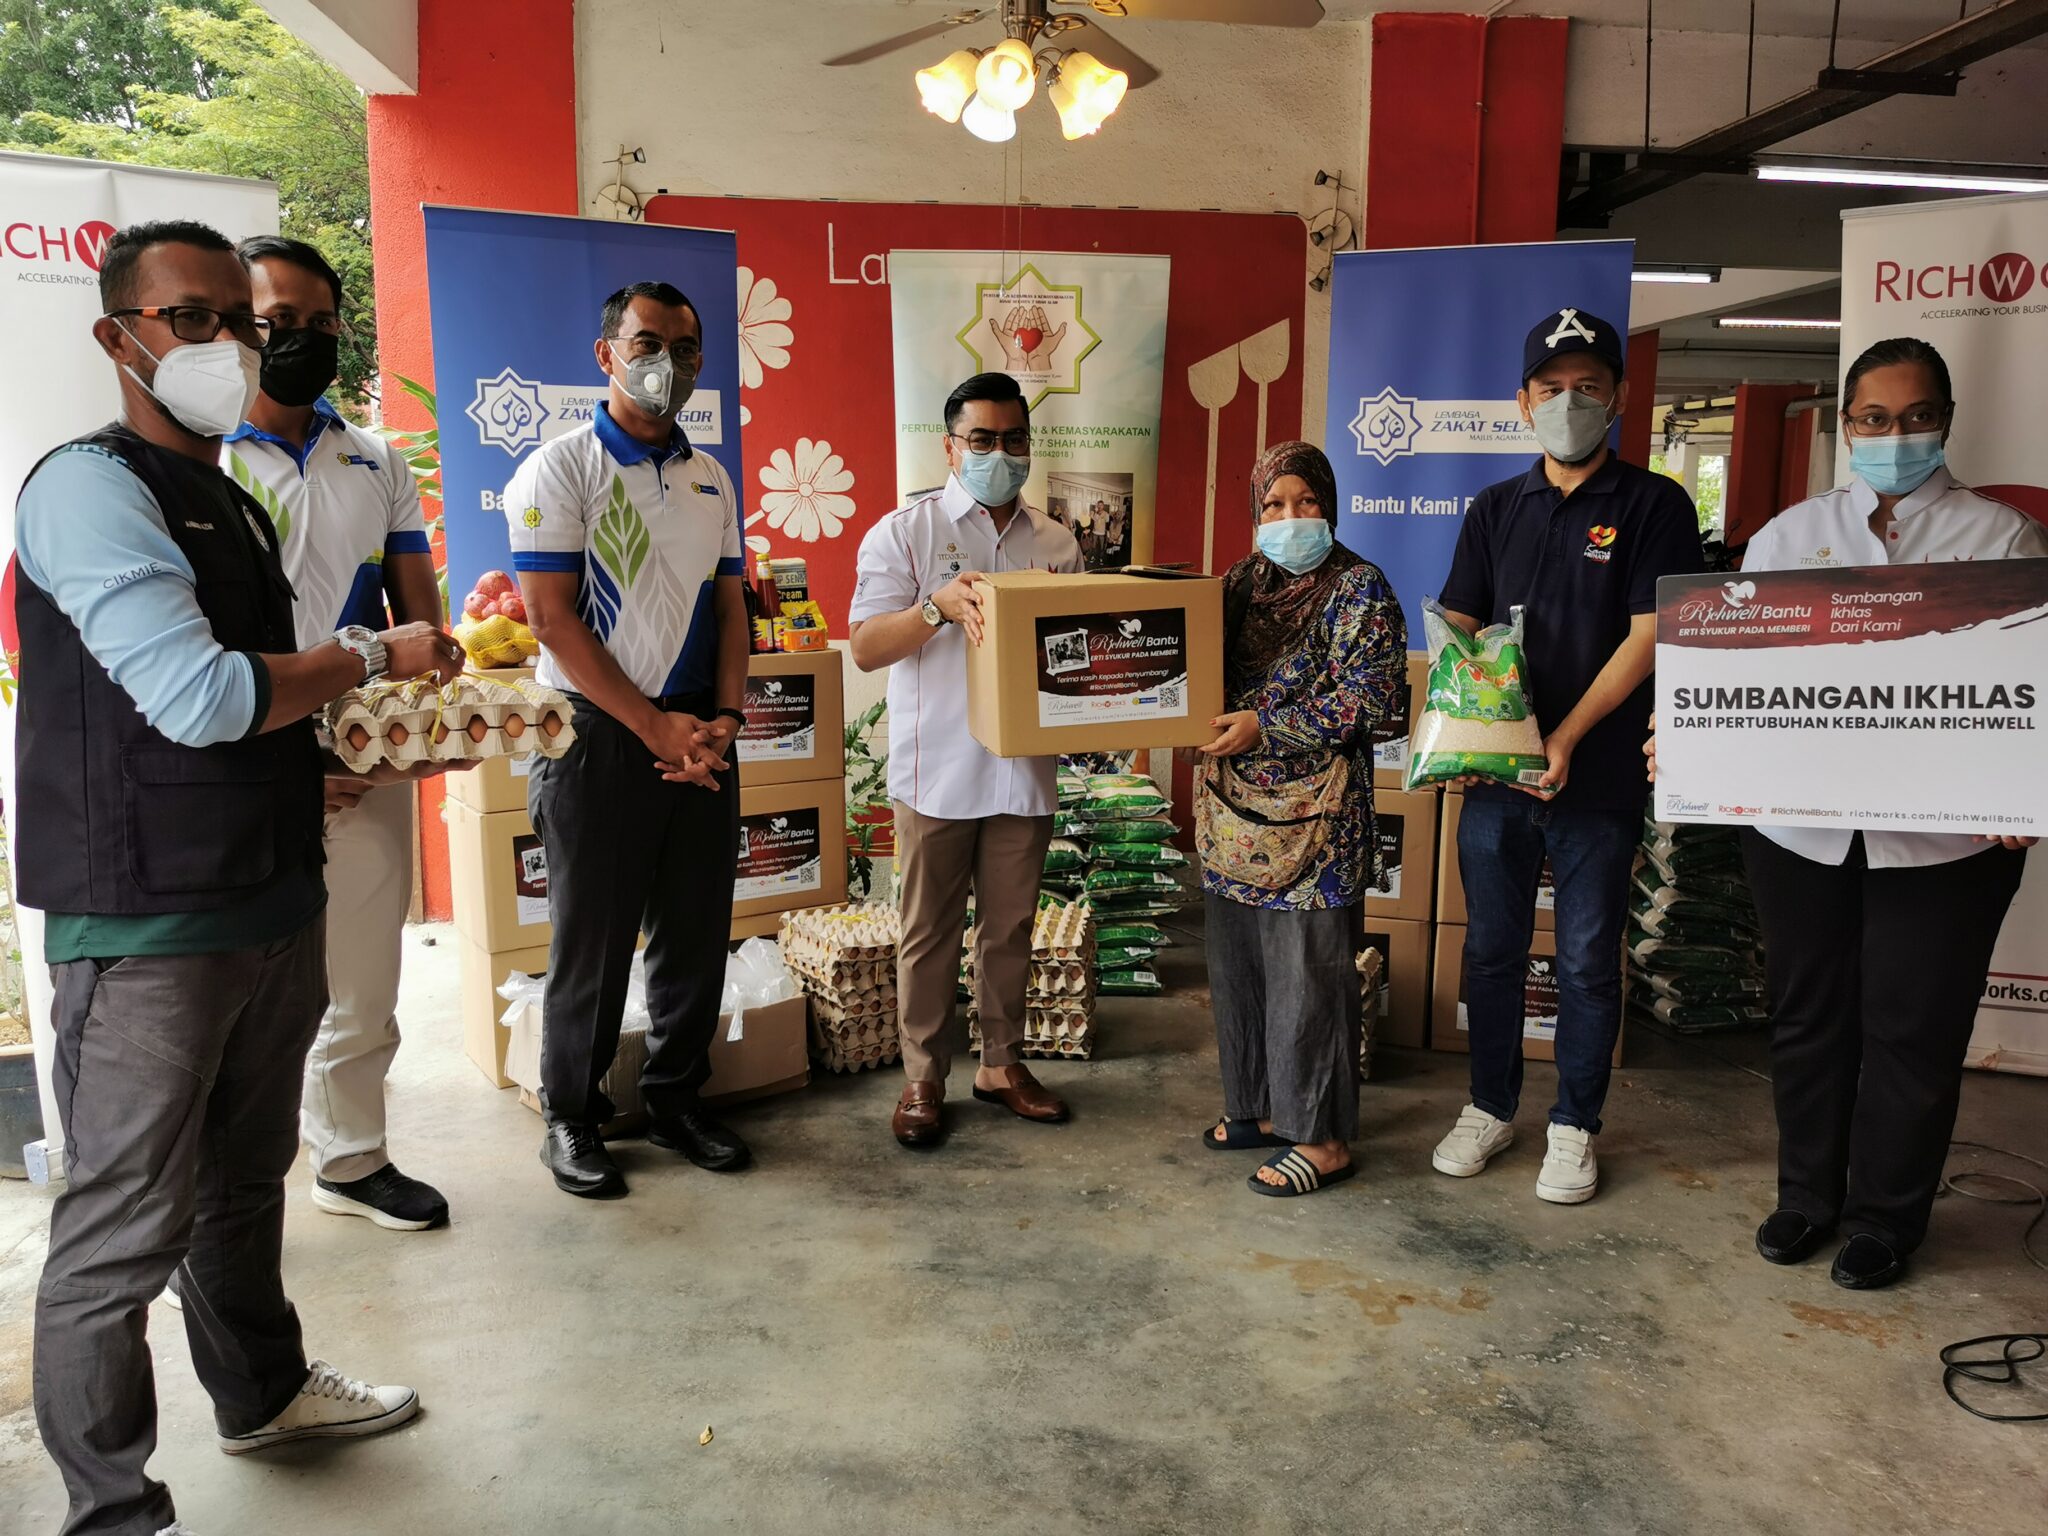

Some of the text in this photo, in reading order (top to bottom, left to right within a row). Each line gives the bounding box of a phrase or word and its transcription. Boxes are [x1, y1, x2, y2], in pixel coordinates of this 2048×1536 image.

[828, 222, 891, 285] La
[18, 272, 94, 286] ACCELERATING
[1921, 304, 2048, 319] ACCELERATING YOUR BUSIN
[561, 397, 599, 406] LEMBA
[558, 408, 593, 420] ZAK
[1435, 411, 1480, 419] LEMBAGA
[902, 423, 949, 434] PERTUBU
[1051, 426, 1151, 437] KEMASYARAKATAN
[1430, 421, 1533, 432] ZAKAT SELA
[1047, 439, 1076, 448] SHAH
[1078, 440, 1110, 449] ALAM
[1351, 495, 1405, 514] Bantu
[1411, 496, 1458, 515] Kami
[103, 562, 162, 589] CIKMIE
[1831, 591, 1923, 606] Sumbangan
[1762, 606, 1811, 619] Bantu
[1831, 607, 1872, 619] Ikhlas
[1679, 624, 1811, 636] ERTI SYUKUR PADA MEMBERI
[1830, 619, 1902, 633] Dari Kami
[1146, 636, 1178, 647] Bantu
[1150, 649, 1178, 657] MEMBERI
[1057, 676, 1079, 684] Terima
[1080, 674, 1098, 682] Kasih
[1099, 673, 1124, 681] Kepada
[785, 695, 809, 704] Bantu
[1674, 684, 2035, 710] SUMBANGAN IKHLAS
[1674, 717, 2035, 729] DARI PERTUBUHAN KEBAJIKAN RICHWELL
[1770, 807, 1842, 817] #RichWellBantu
[790, 829, 815, 838] Bantu
[1987, 983, 2048, 1003] orks.c
